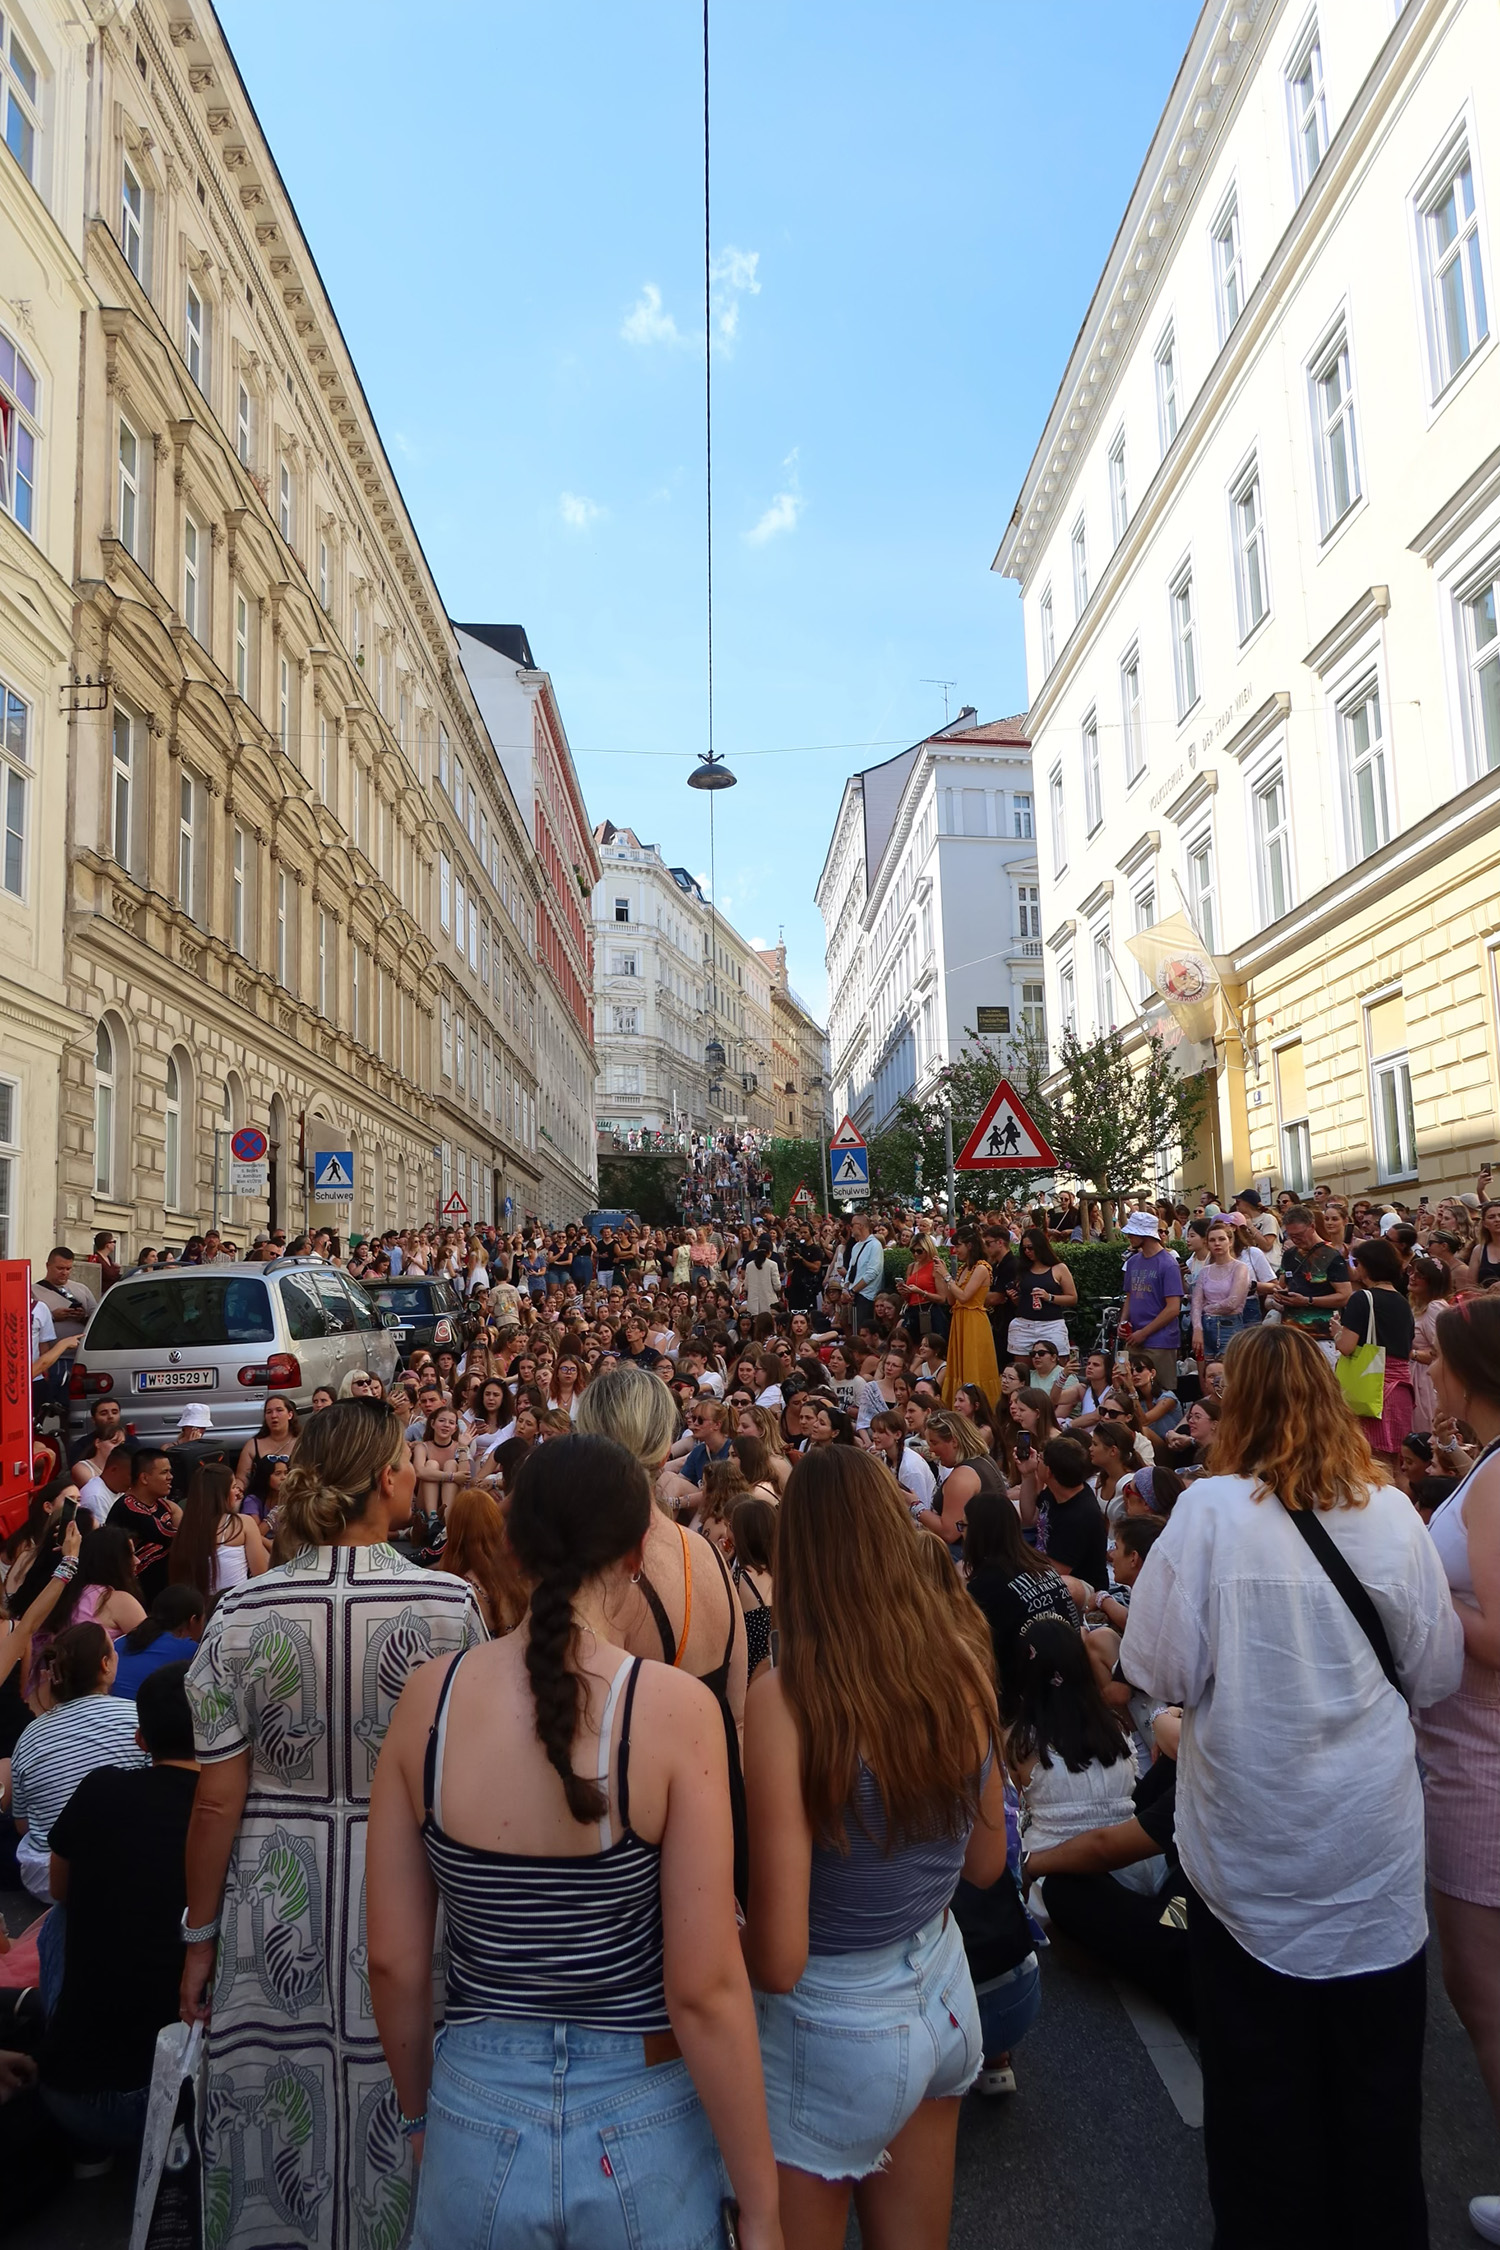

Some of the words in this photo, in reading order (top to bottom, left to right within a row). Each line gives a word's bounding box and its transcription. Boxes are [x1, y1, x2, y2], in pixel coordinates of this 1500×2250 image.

[1202, 729, 1214, 752] DER
[1215, 705, 1233, 737] STADT
[1235, 682, 1253, 712] WIEN
[315, 1191, 354, 1201] Schulweg
[833, 1187, 869, 1196] Schulweg
[1020, 1586, 1040, 1603] THE
[1038, 1579, 1058, 1593] ERAS
[1027, 1593, 1053, 1613] 2023
